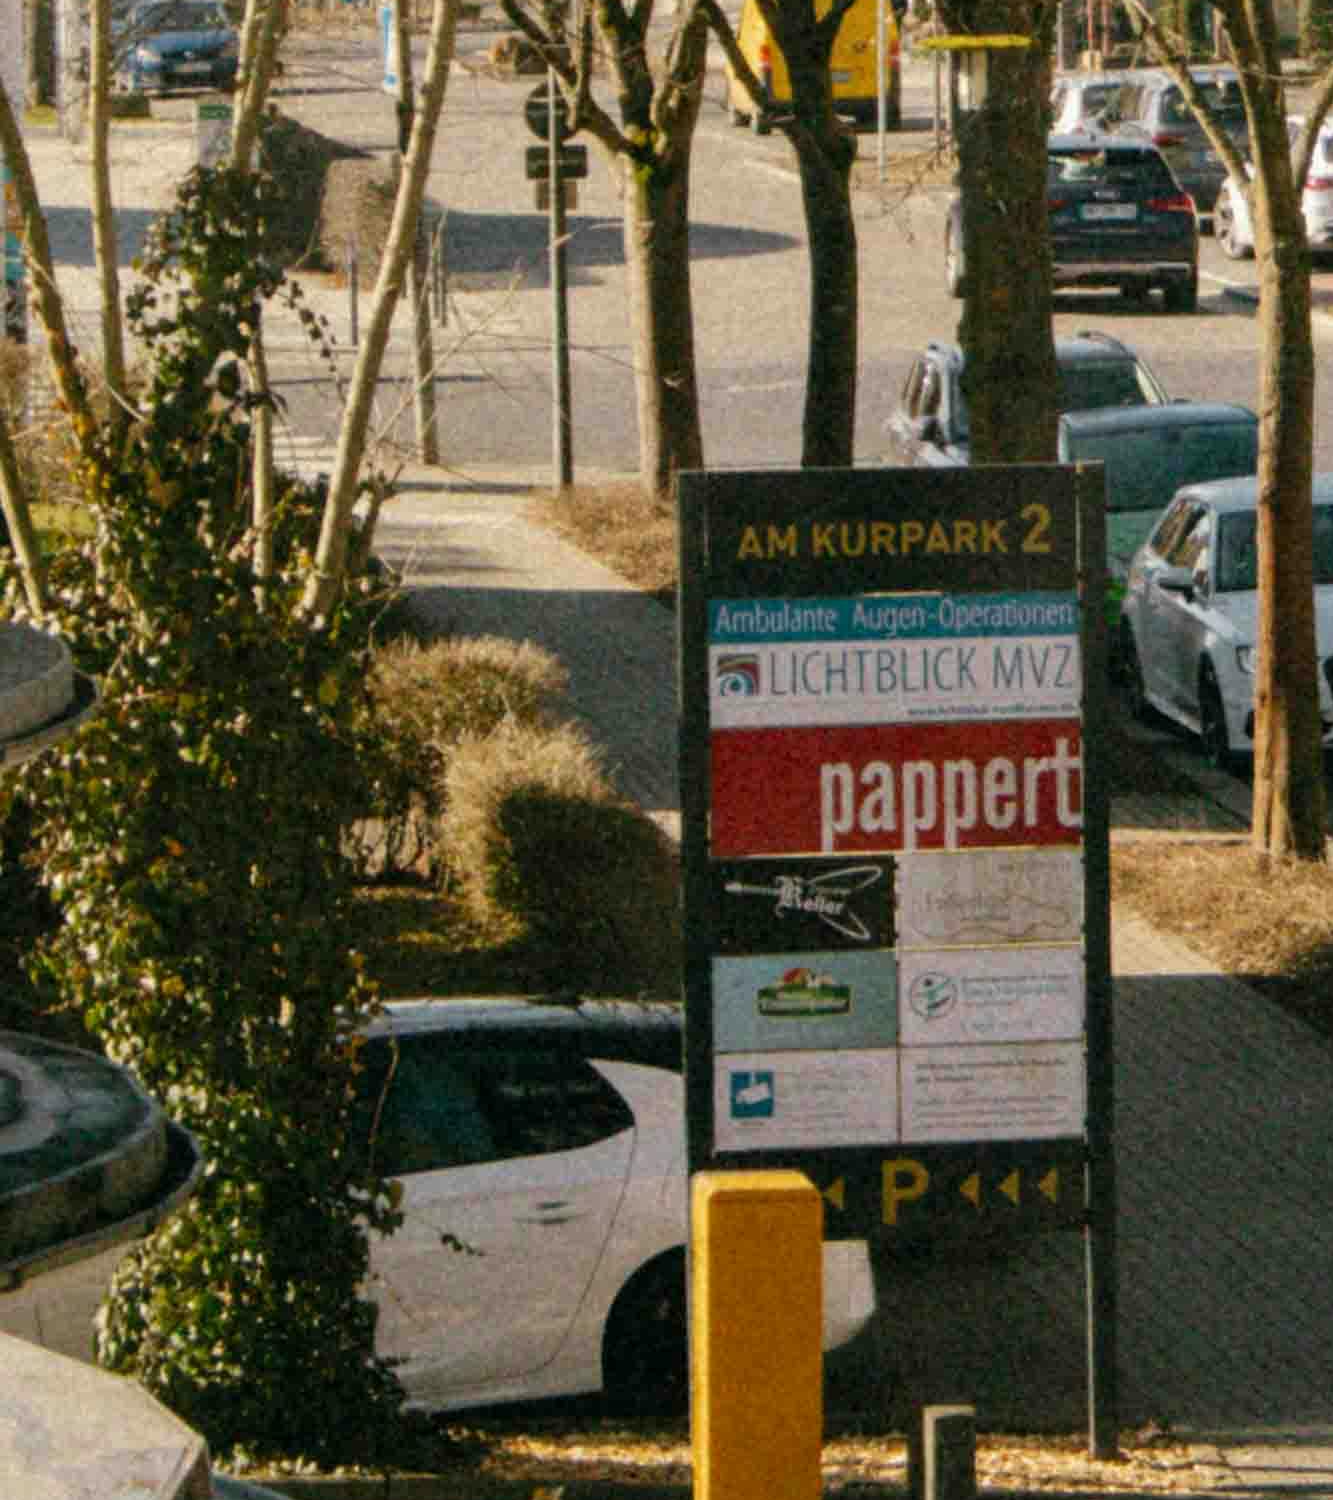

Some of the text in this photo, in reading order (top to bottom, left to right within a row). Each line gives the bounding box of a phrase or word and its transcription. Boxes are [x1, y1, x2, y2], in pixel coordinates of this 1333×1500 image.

[736, 503, 1053, 561] AM KURPARK 2
[715, 598, 1074, 639] Ambulante Augen-Operationen
[769, 643, 1074, 697] LICHTBLICK MVZ
[819, 736, 1084, 854] pappert
[881, 1159, 929, 1225] P
